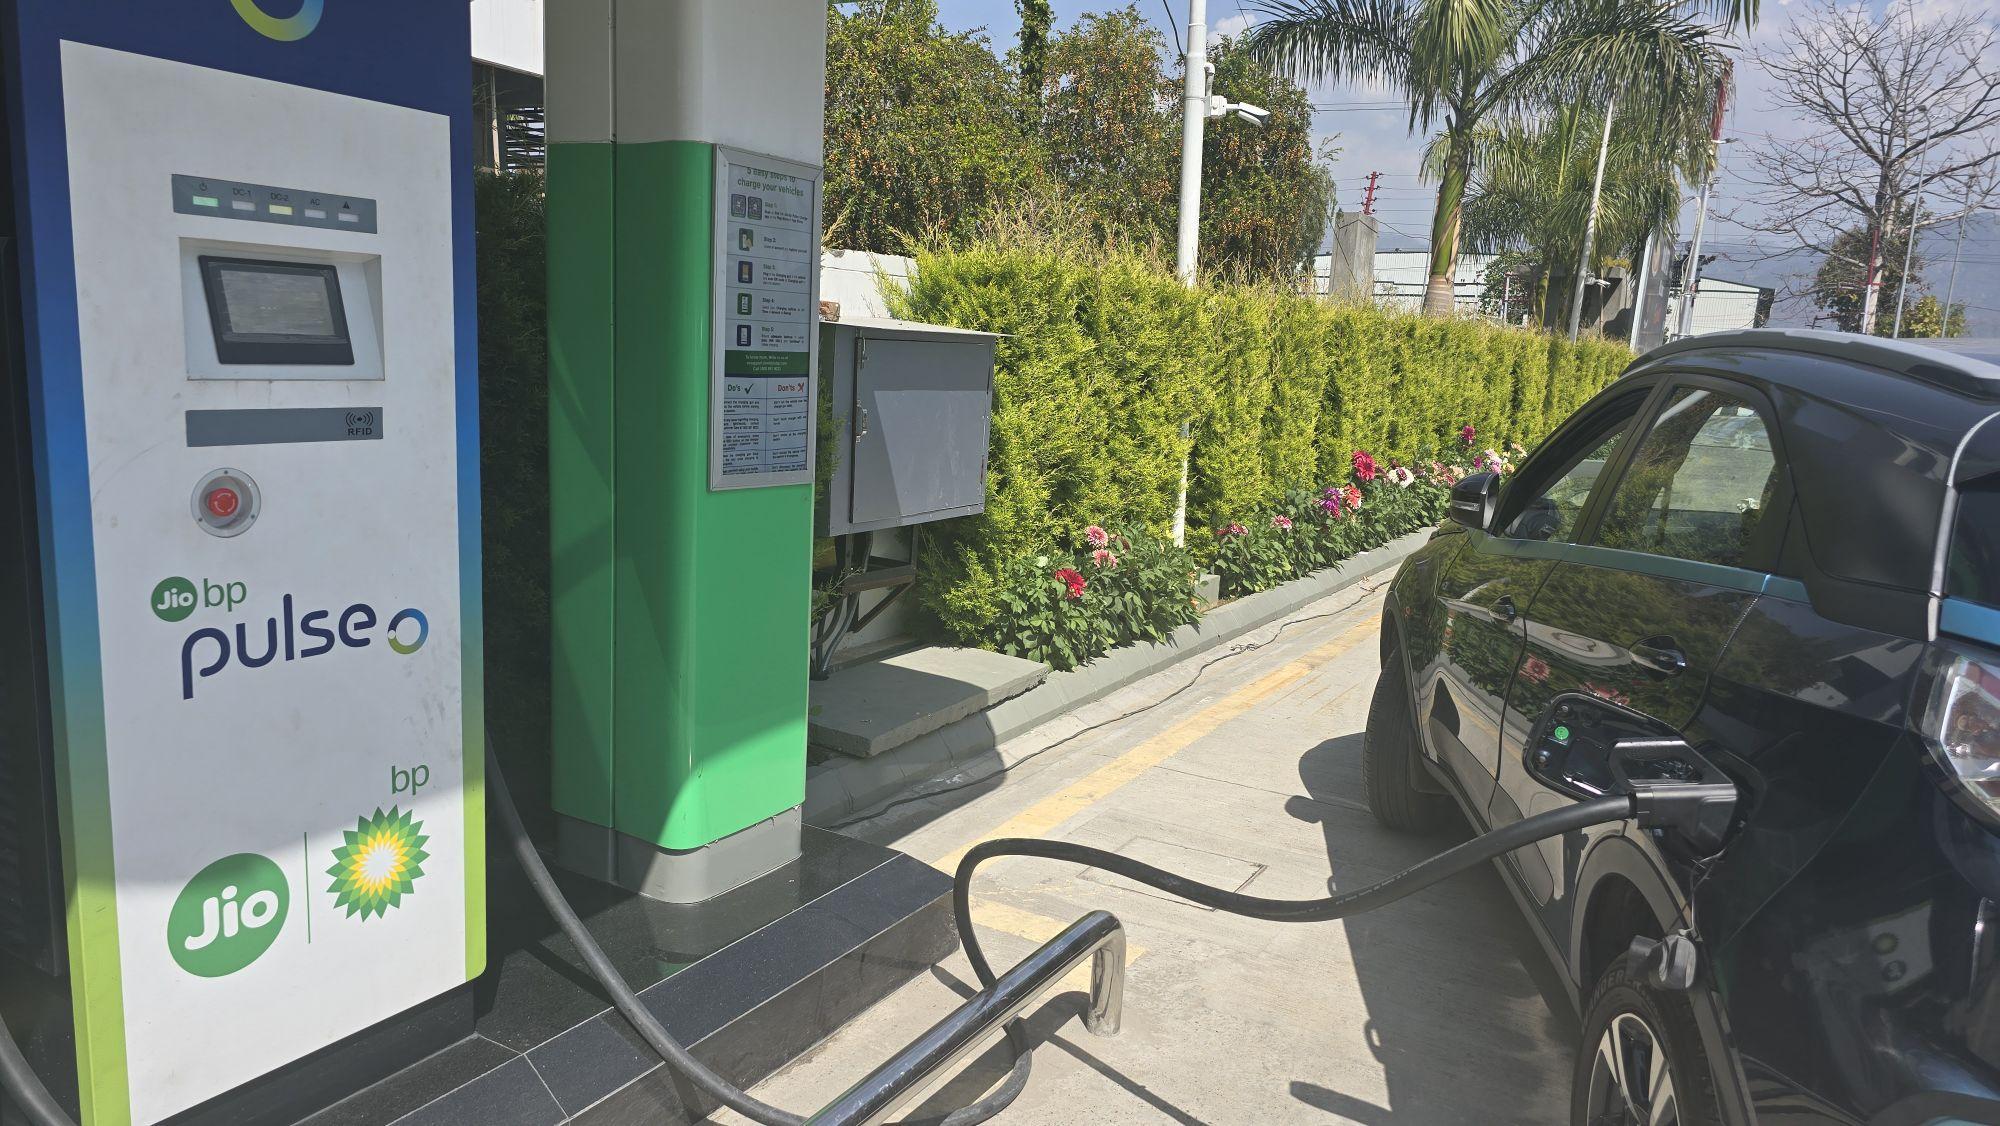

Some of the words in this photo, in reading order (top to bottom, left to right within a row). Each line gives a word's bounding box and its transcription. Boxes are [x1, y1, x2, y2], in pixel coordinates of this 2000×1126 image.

[232, 187, 251, 196] DC-1
[737, 177, 761, 190] charge
[762, 183, 777, 192] your
[778, 185, 804, 197] vehicles
[270, 192, 289, 202] DC-2
[310, 198, 321, 206] AC
[727, 384, 741, 392] Do's
[347, 427, 373, 436] RFID
[157, 587, 194, 610] Jio
[203, 577, 247, 612] bp
[181, 593, 377, 700] pulse
[391, 764, 430, 796] bp
[184, 885, 279, 950] Jio
